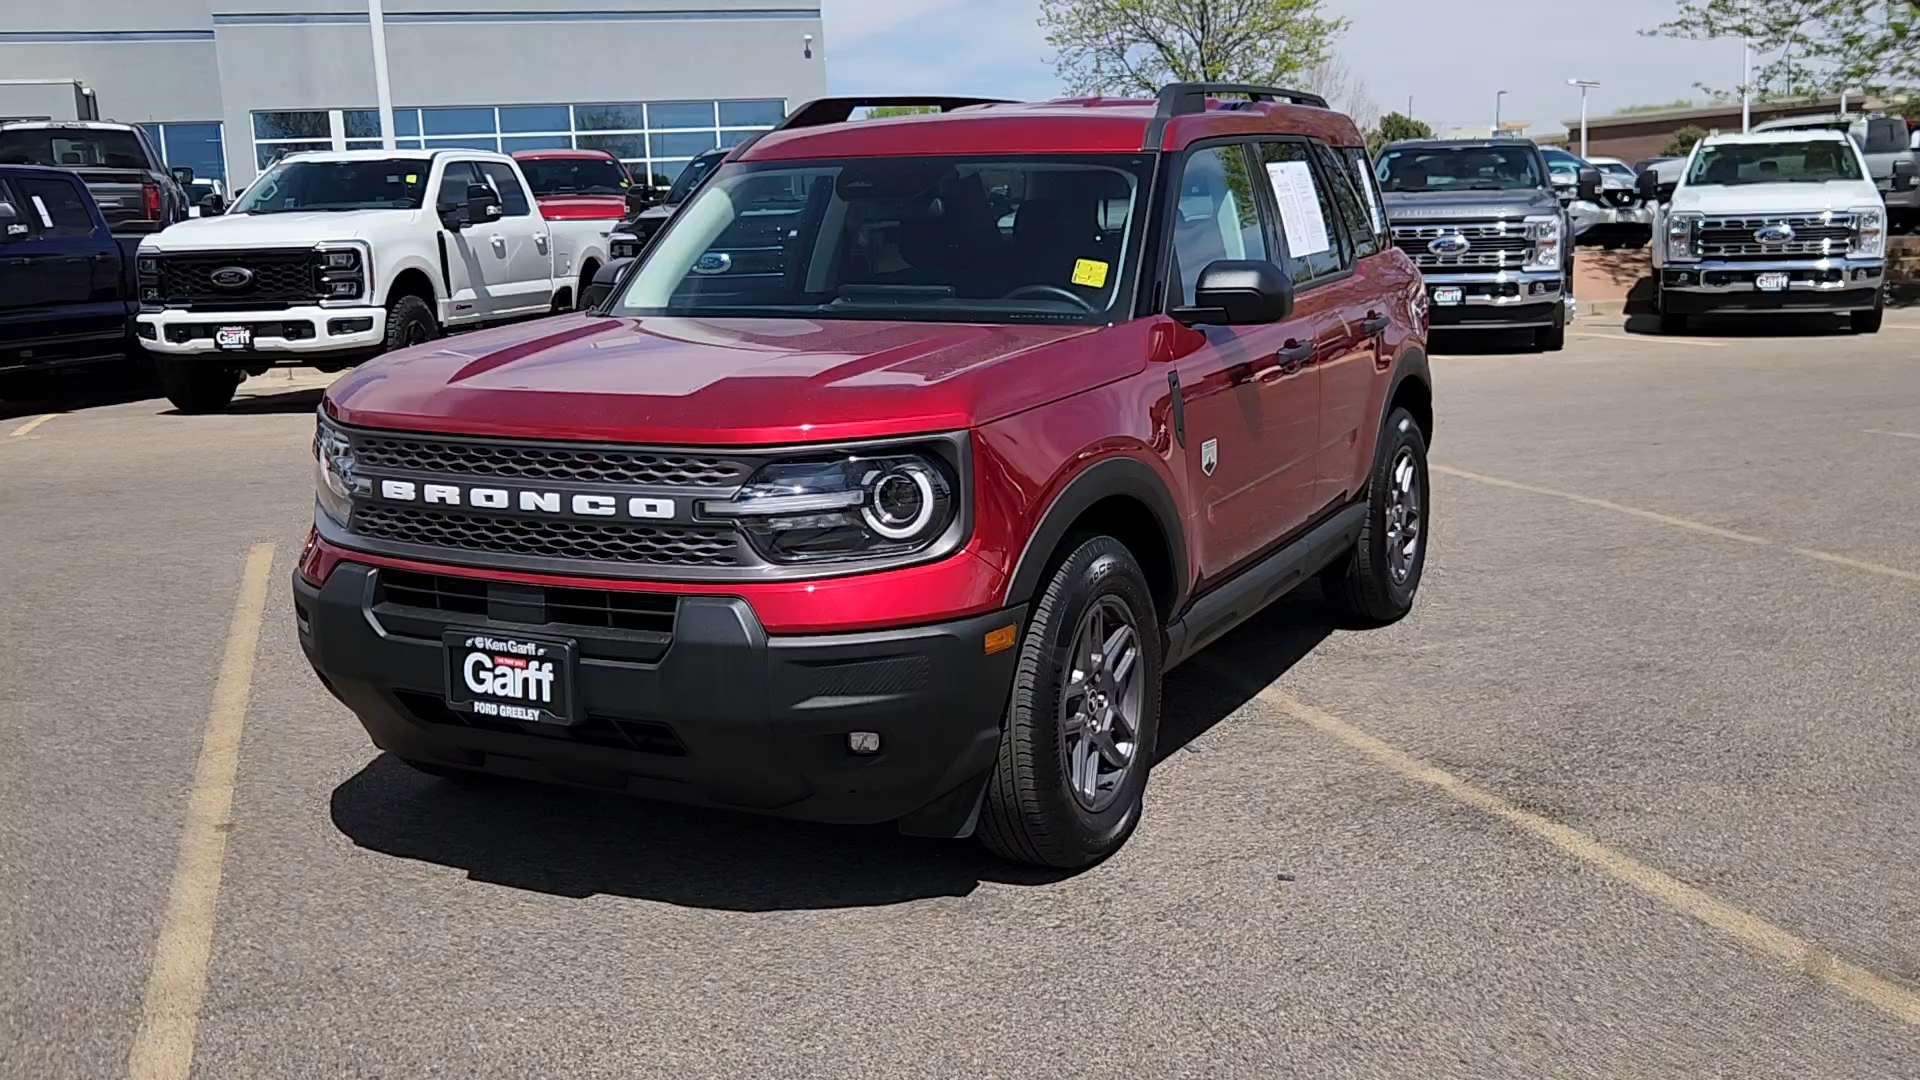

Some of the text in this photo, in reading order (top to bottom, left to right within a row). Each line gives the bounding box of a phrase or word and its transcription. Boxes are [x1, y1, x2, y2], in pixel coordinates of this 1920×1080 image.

[216, 330, 250, 344] Garff
[381, 479, 676, 519] BRONCO
[485, 638, 536, 656] Ken Garff
[464, 652, 554, 702] Garff
[474, 702, 540, 721] FORD GREELEY
